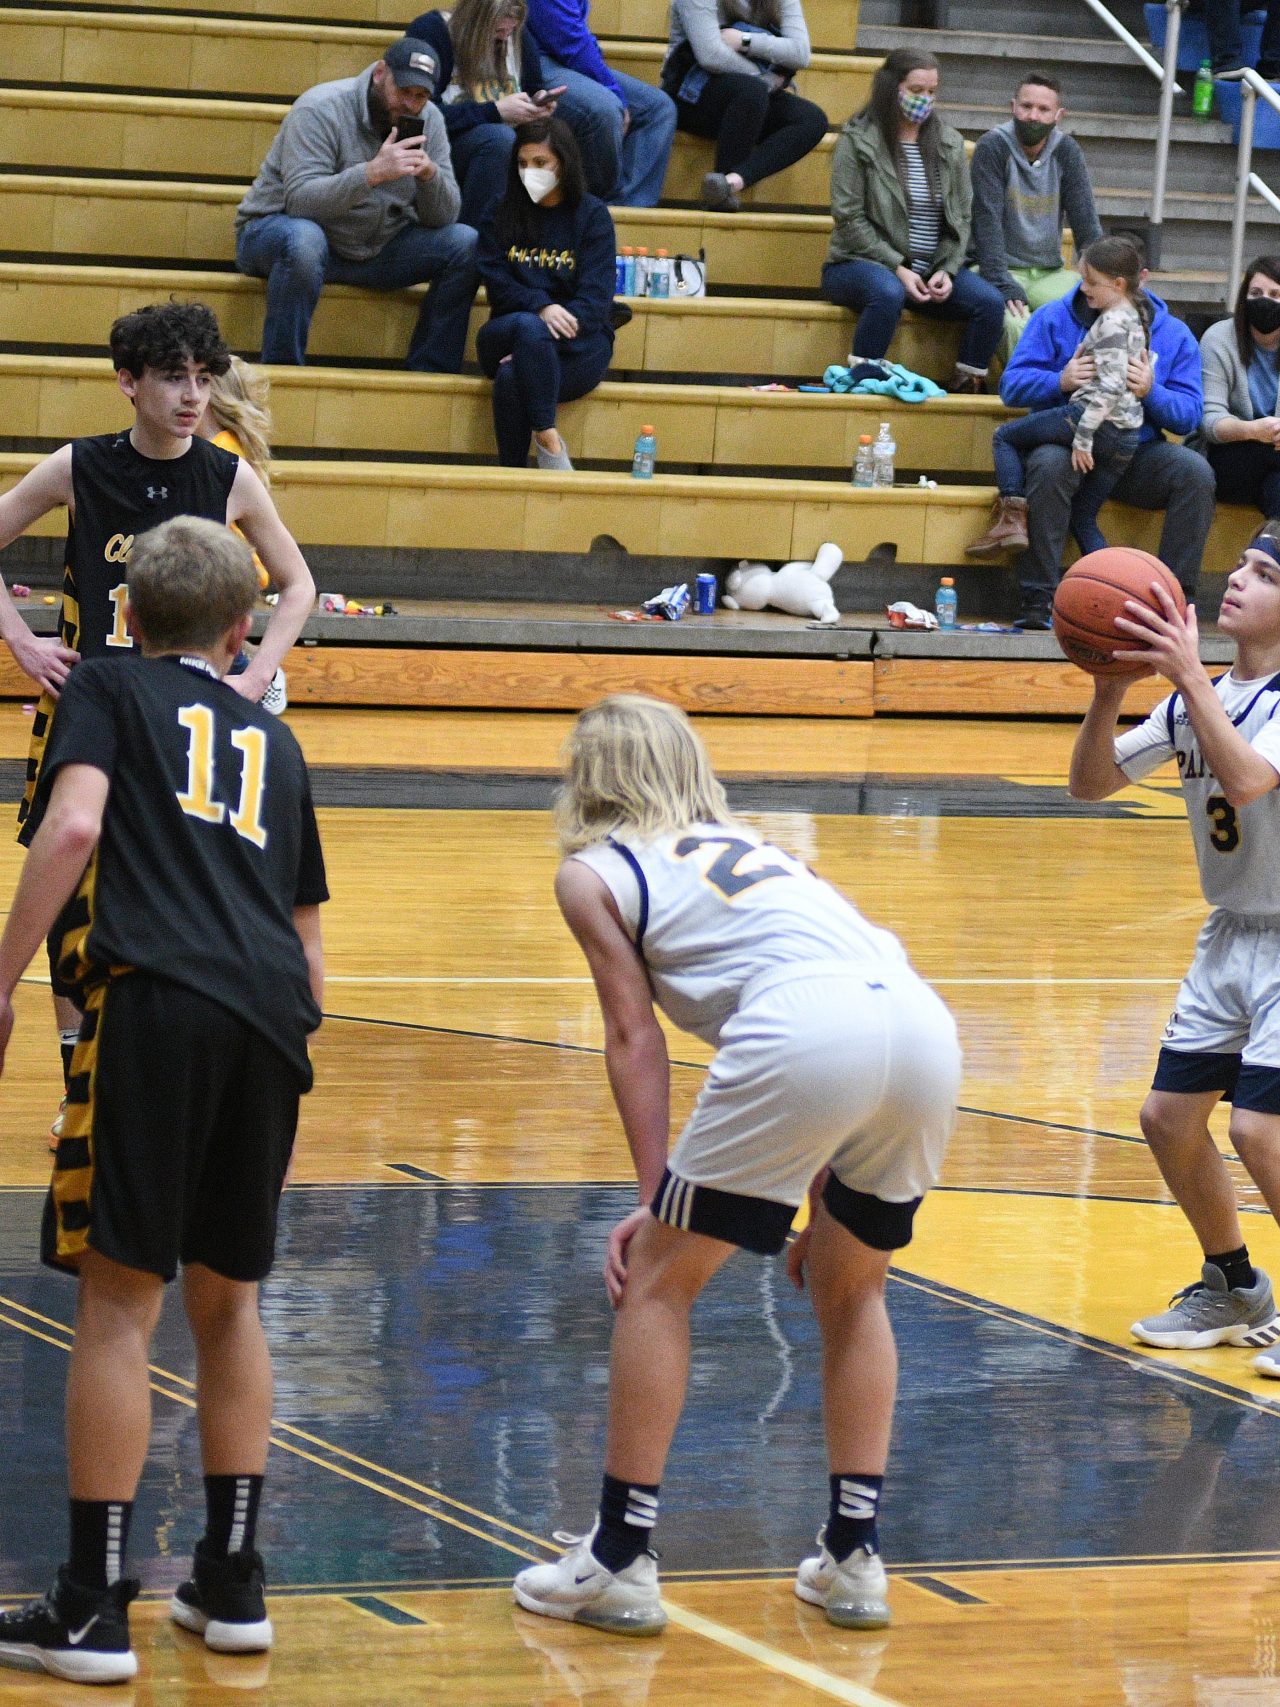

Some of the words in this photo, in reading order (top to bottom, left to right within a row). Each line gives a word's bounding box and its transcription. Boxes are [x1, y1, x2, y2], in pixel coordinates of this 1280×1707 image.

[507, 245, 576, 270] ANTHERS
[104, 533, 135, 563] Cl
[105, 583, 134, 648] 1
[179, 656, 206, 671] NIKE
[175, 703, 269, 850] 11
[1205, 794, 1243, 854] 3
